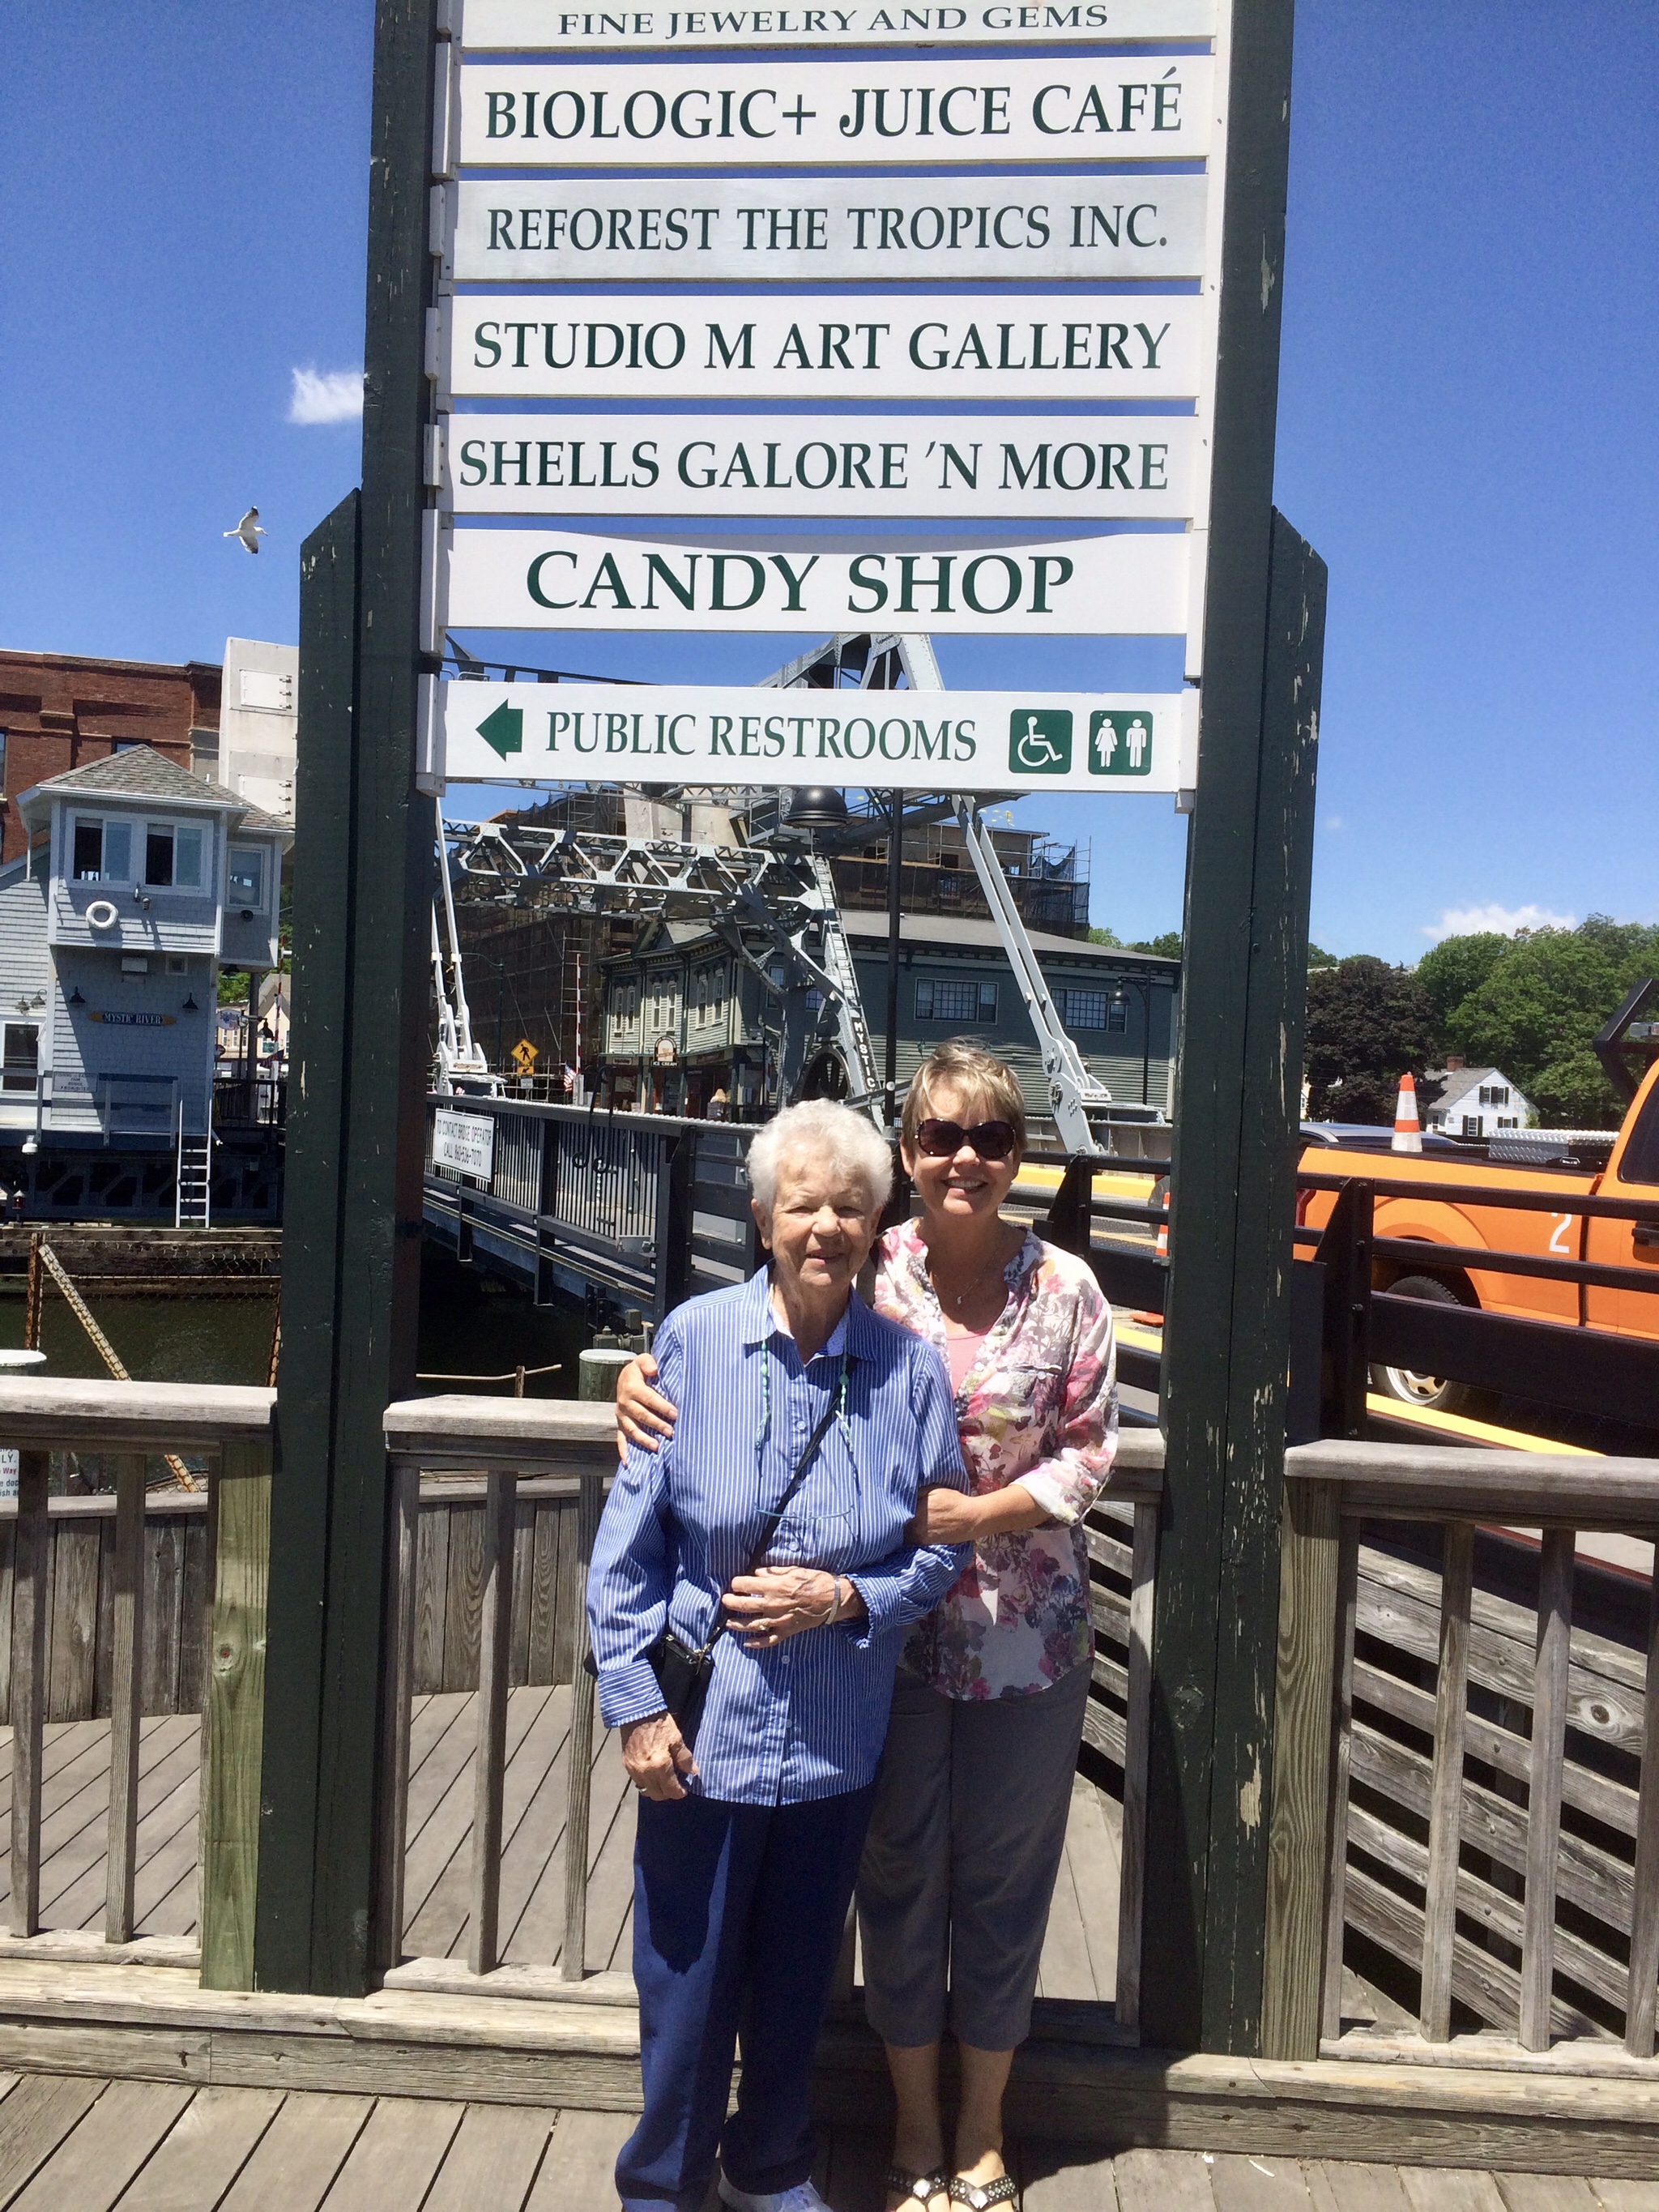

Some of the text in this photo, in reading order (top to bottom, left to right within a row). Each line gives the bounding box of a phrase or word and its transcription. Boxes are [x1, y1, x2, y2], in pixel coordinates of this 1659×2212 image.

[557, 5, 1109, 40] FINE JEWELRY AND GEMS
[484, 66, 1182, 139] BIOLOGIC+ JUICE CAFÉ
[486, 203, 1167, 251] REFOREST THE TROPICS INC.
[474, 321, 1171, 370] STUDIO M ART GALLERY
[459, 439, 659, 489] SHELLS
[677, 441, 908, 489] GALORE
[998, 442, 1168, 491] MORE
[527, 550, 1075, 614] CANDY SHOP
[545, 711, 977, 762] PUBLIC RESTROOMS
[104, 1012, 161, 1024] MYSTIC RIVER
[853, 1021, 876, 1088] MYSTIC
[471, 1125, 492, 1147] OPERATOR
[1549, 1211, 1572, 1253] 2
[0, 1454, 16, 1463] LY.
